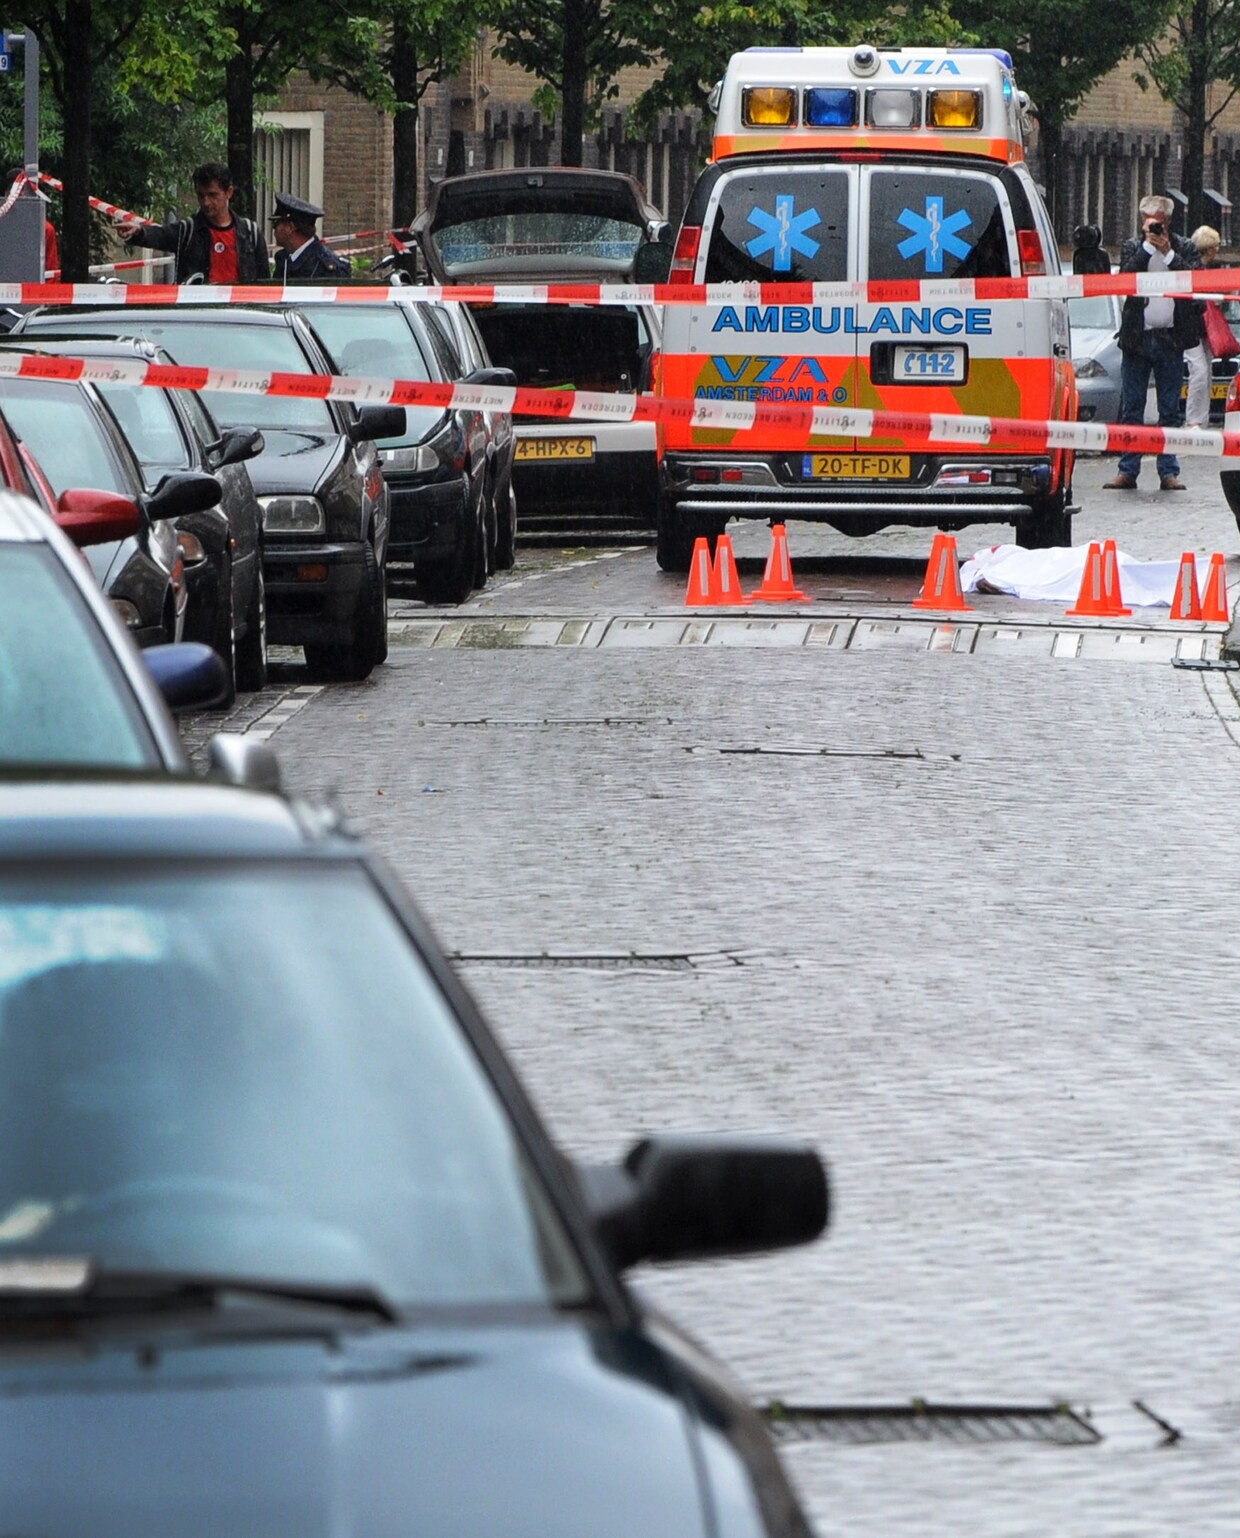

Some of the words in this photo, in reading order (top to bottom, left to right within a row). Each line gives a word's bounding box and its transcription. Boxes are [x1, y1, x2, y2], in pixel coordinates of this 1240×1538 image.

[886, 59, 960, 75] VZA
[711, 305, 993, 335] AMBULANCE
[711, 355, 829, 383] VZA
[695, 385, 814, 403] AMSTERDAM
[817, 388, 829, 402] &
[832, 386, 848, 404] O
[484, 397, 503, 405] NIET
[582, 403, 626, 413] BETREDEN
[672, 407, 712, 418] POLITIE
[814, 415, 855, 427] POLITIE
[957, 424, 997, 435] POLITIE
[1057, 431, 1074, 439] NIET
[518, 440, 586, 456] 4-HPX-6
[1197, 439, 1214, 447] NIET
[818, 458, 903, 474] 20-TF-DK
